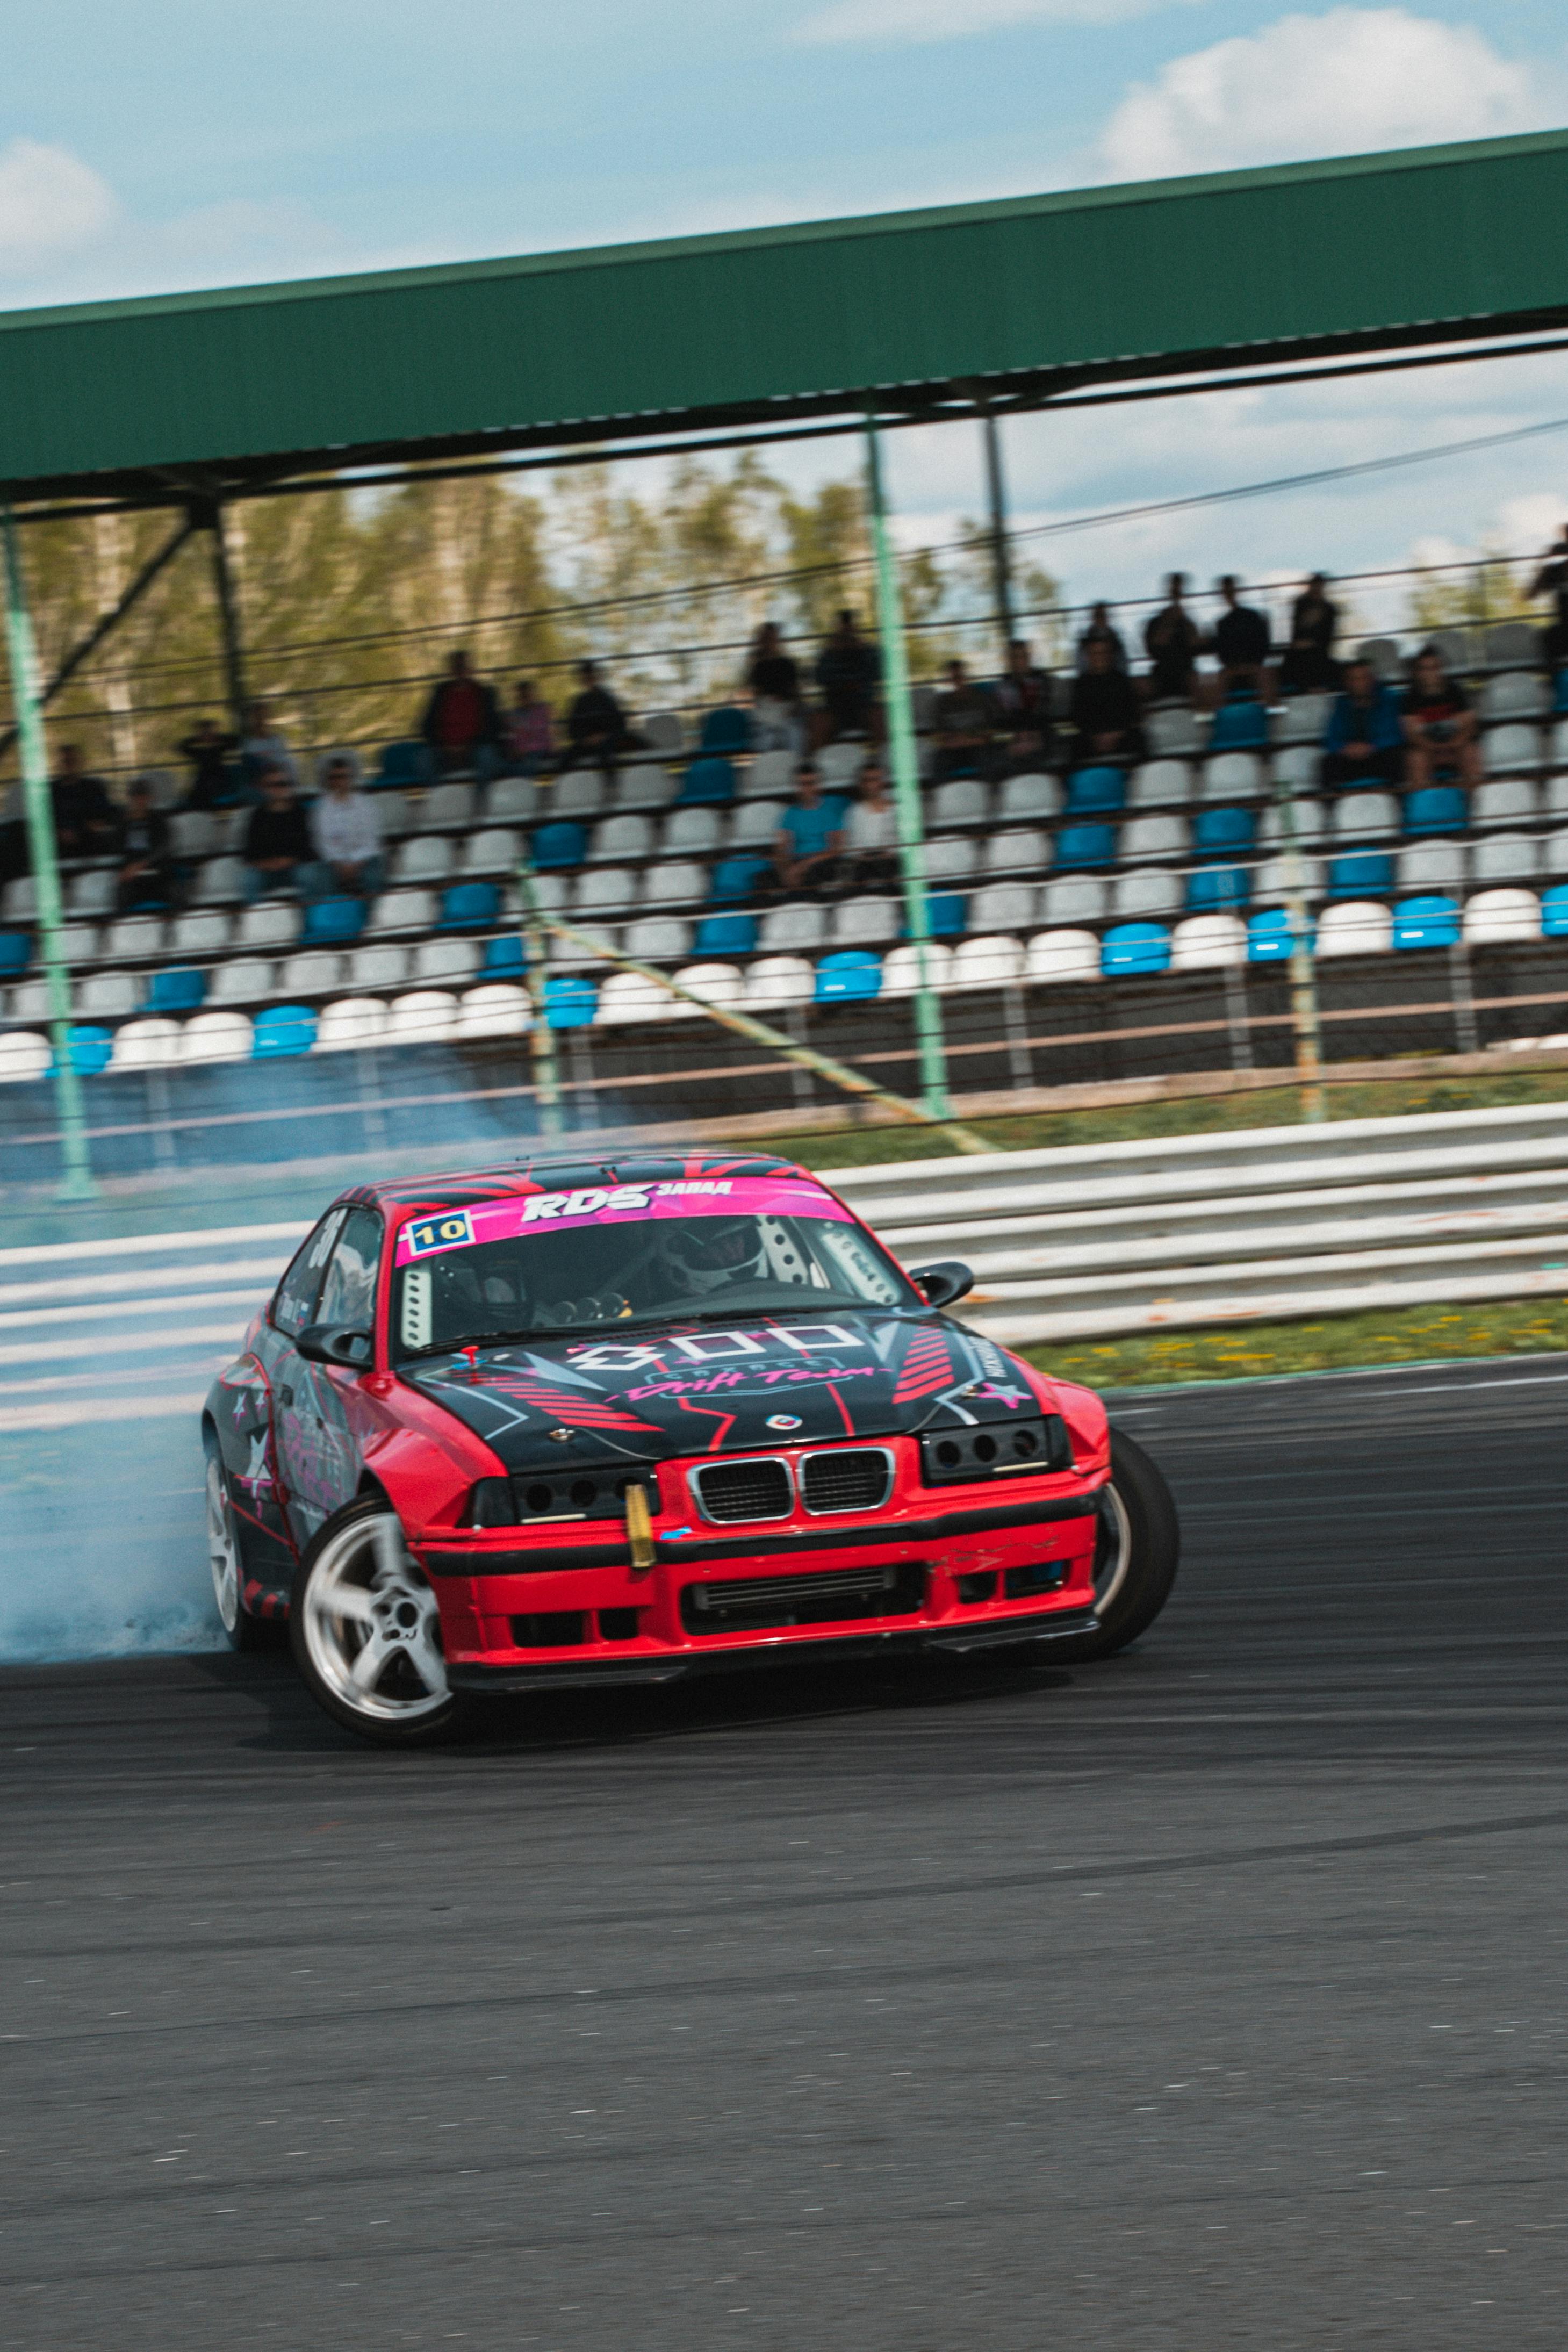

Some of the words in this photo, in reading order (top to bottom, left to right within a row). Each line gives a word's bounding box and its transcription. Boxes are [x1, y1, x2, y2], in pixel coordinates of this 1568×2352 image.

[521, 1184, 655, 1222] RDS
[415, 1220, 466, 1245] 10
[622, 1371, 749, 1402] Drift
[753, 1366, 874, 1384] Team
